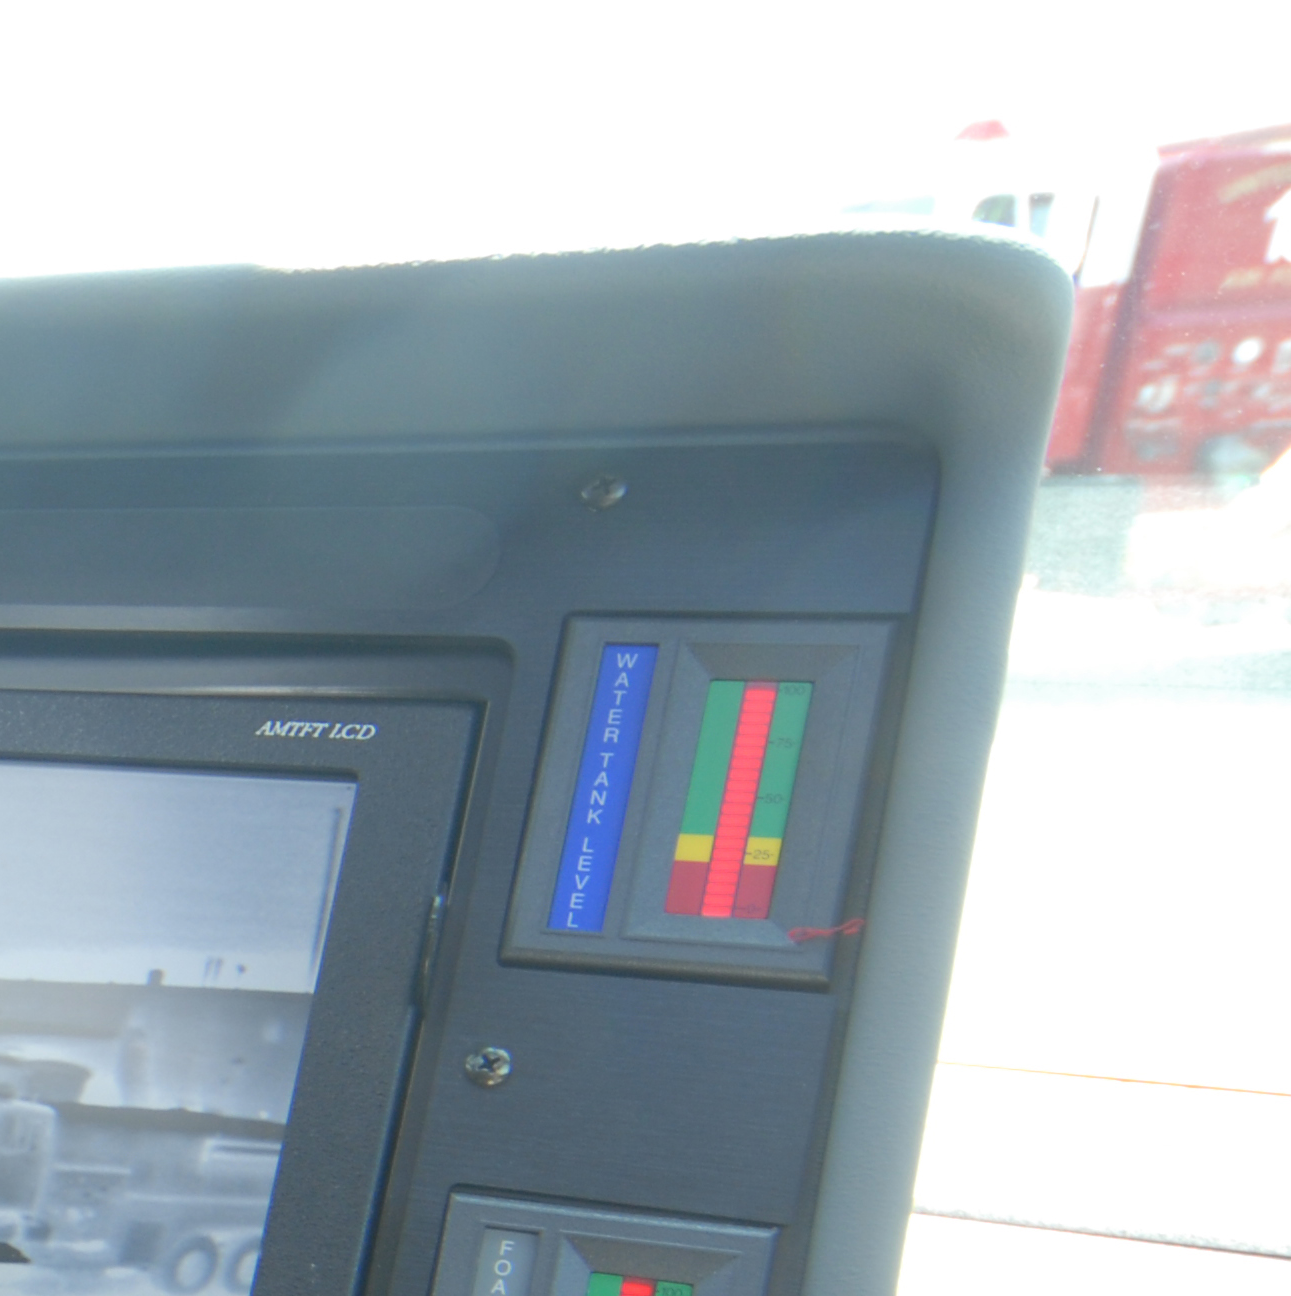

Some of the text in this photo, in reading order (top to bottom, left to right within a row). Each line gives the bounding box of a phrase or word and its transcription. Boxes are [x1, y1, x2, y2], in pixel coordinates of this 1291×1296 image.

[255, 720, 377, 740] AMTFT LCD
[776, 738, 793, 749] 75
[566, 653, 639, 929] WATER TANK LEVEL
[752, 850, 770, 861] 25
